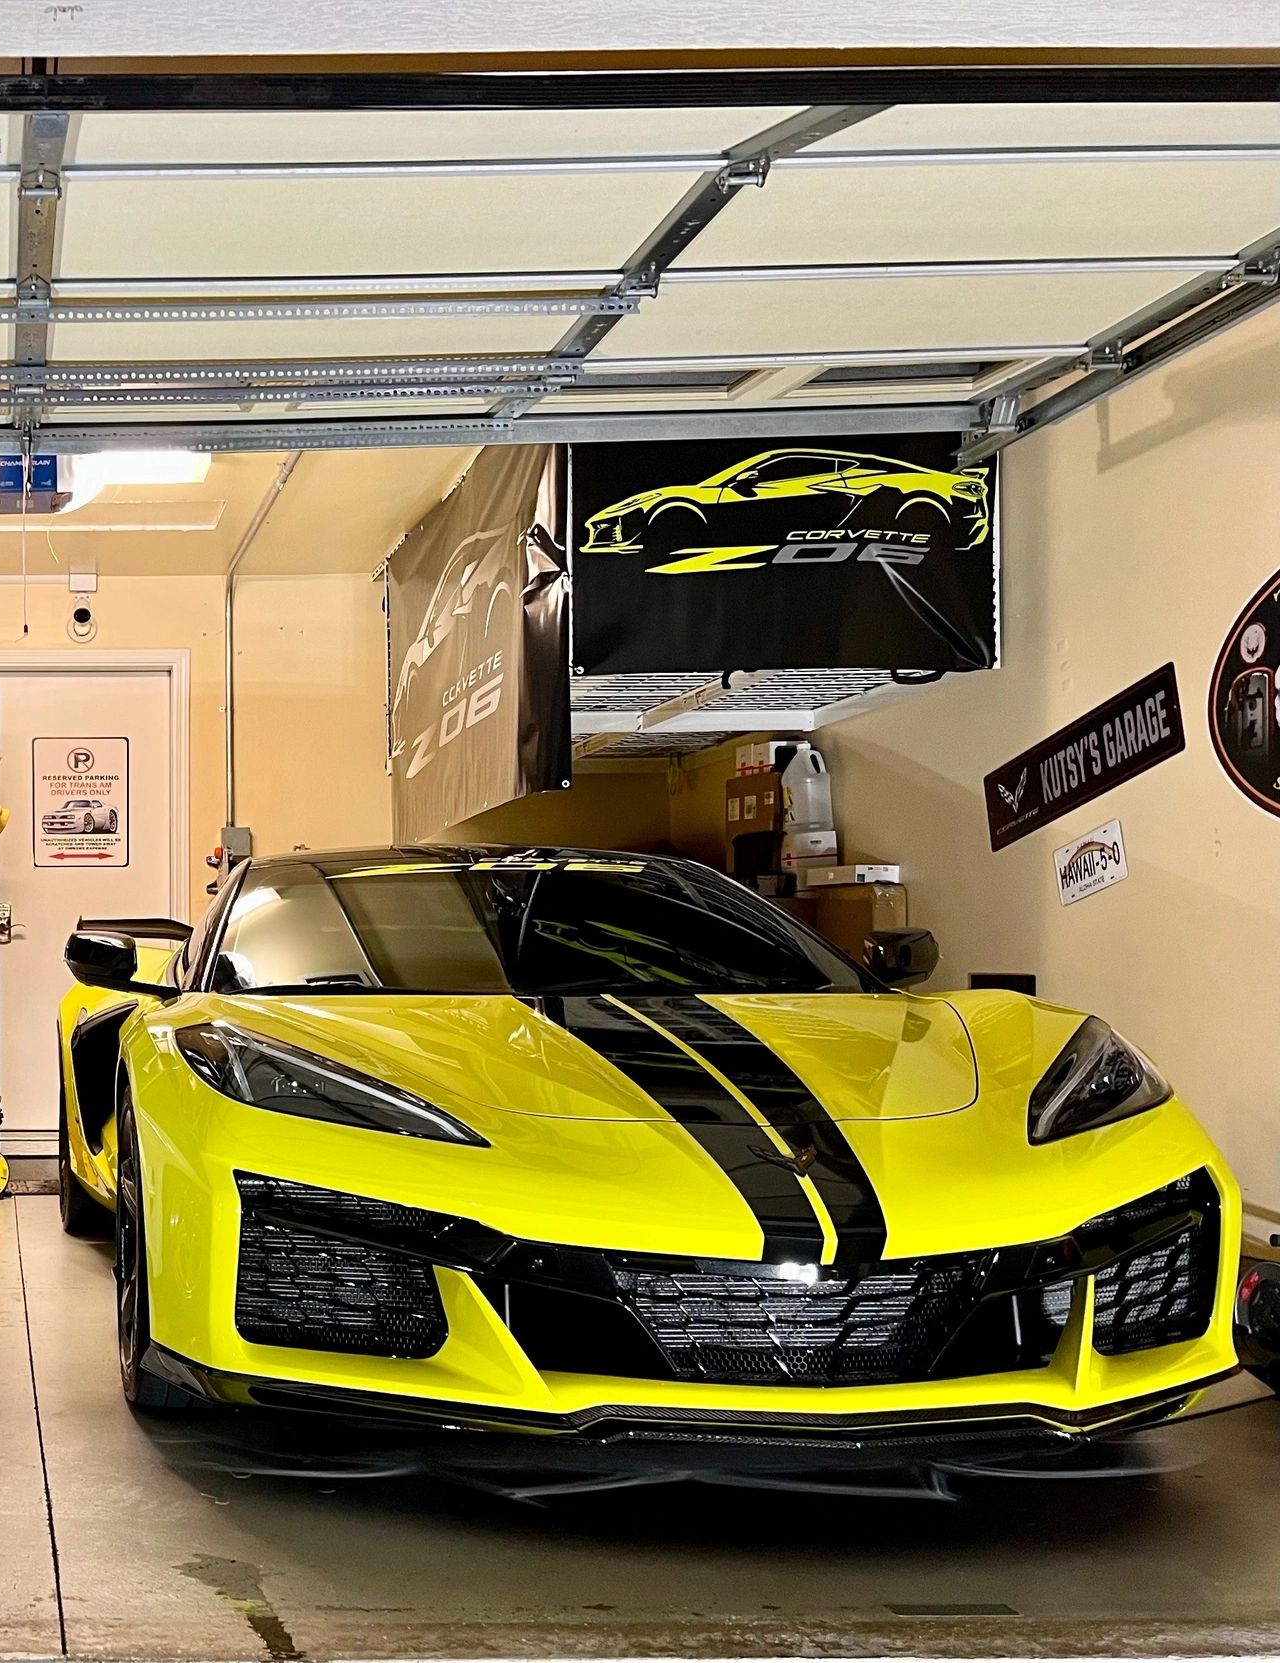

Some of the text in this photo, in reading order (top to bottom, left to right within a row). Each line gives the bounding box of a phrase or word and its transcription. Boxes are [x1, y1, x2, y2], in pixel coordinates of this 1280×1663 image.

[645, 542, 930, 574] Z06
[786, 529, 931, 543] CORVETTE
[442, 650, 503, 707] CORVETTE
[406, 672, 504, 779] Z06
[1040, 690, 1170, 804] KUTSY'S GARAGE
